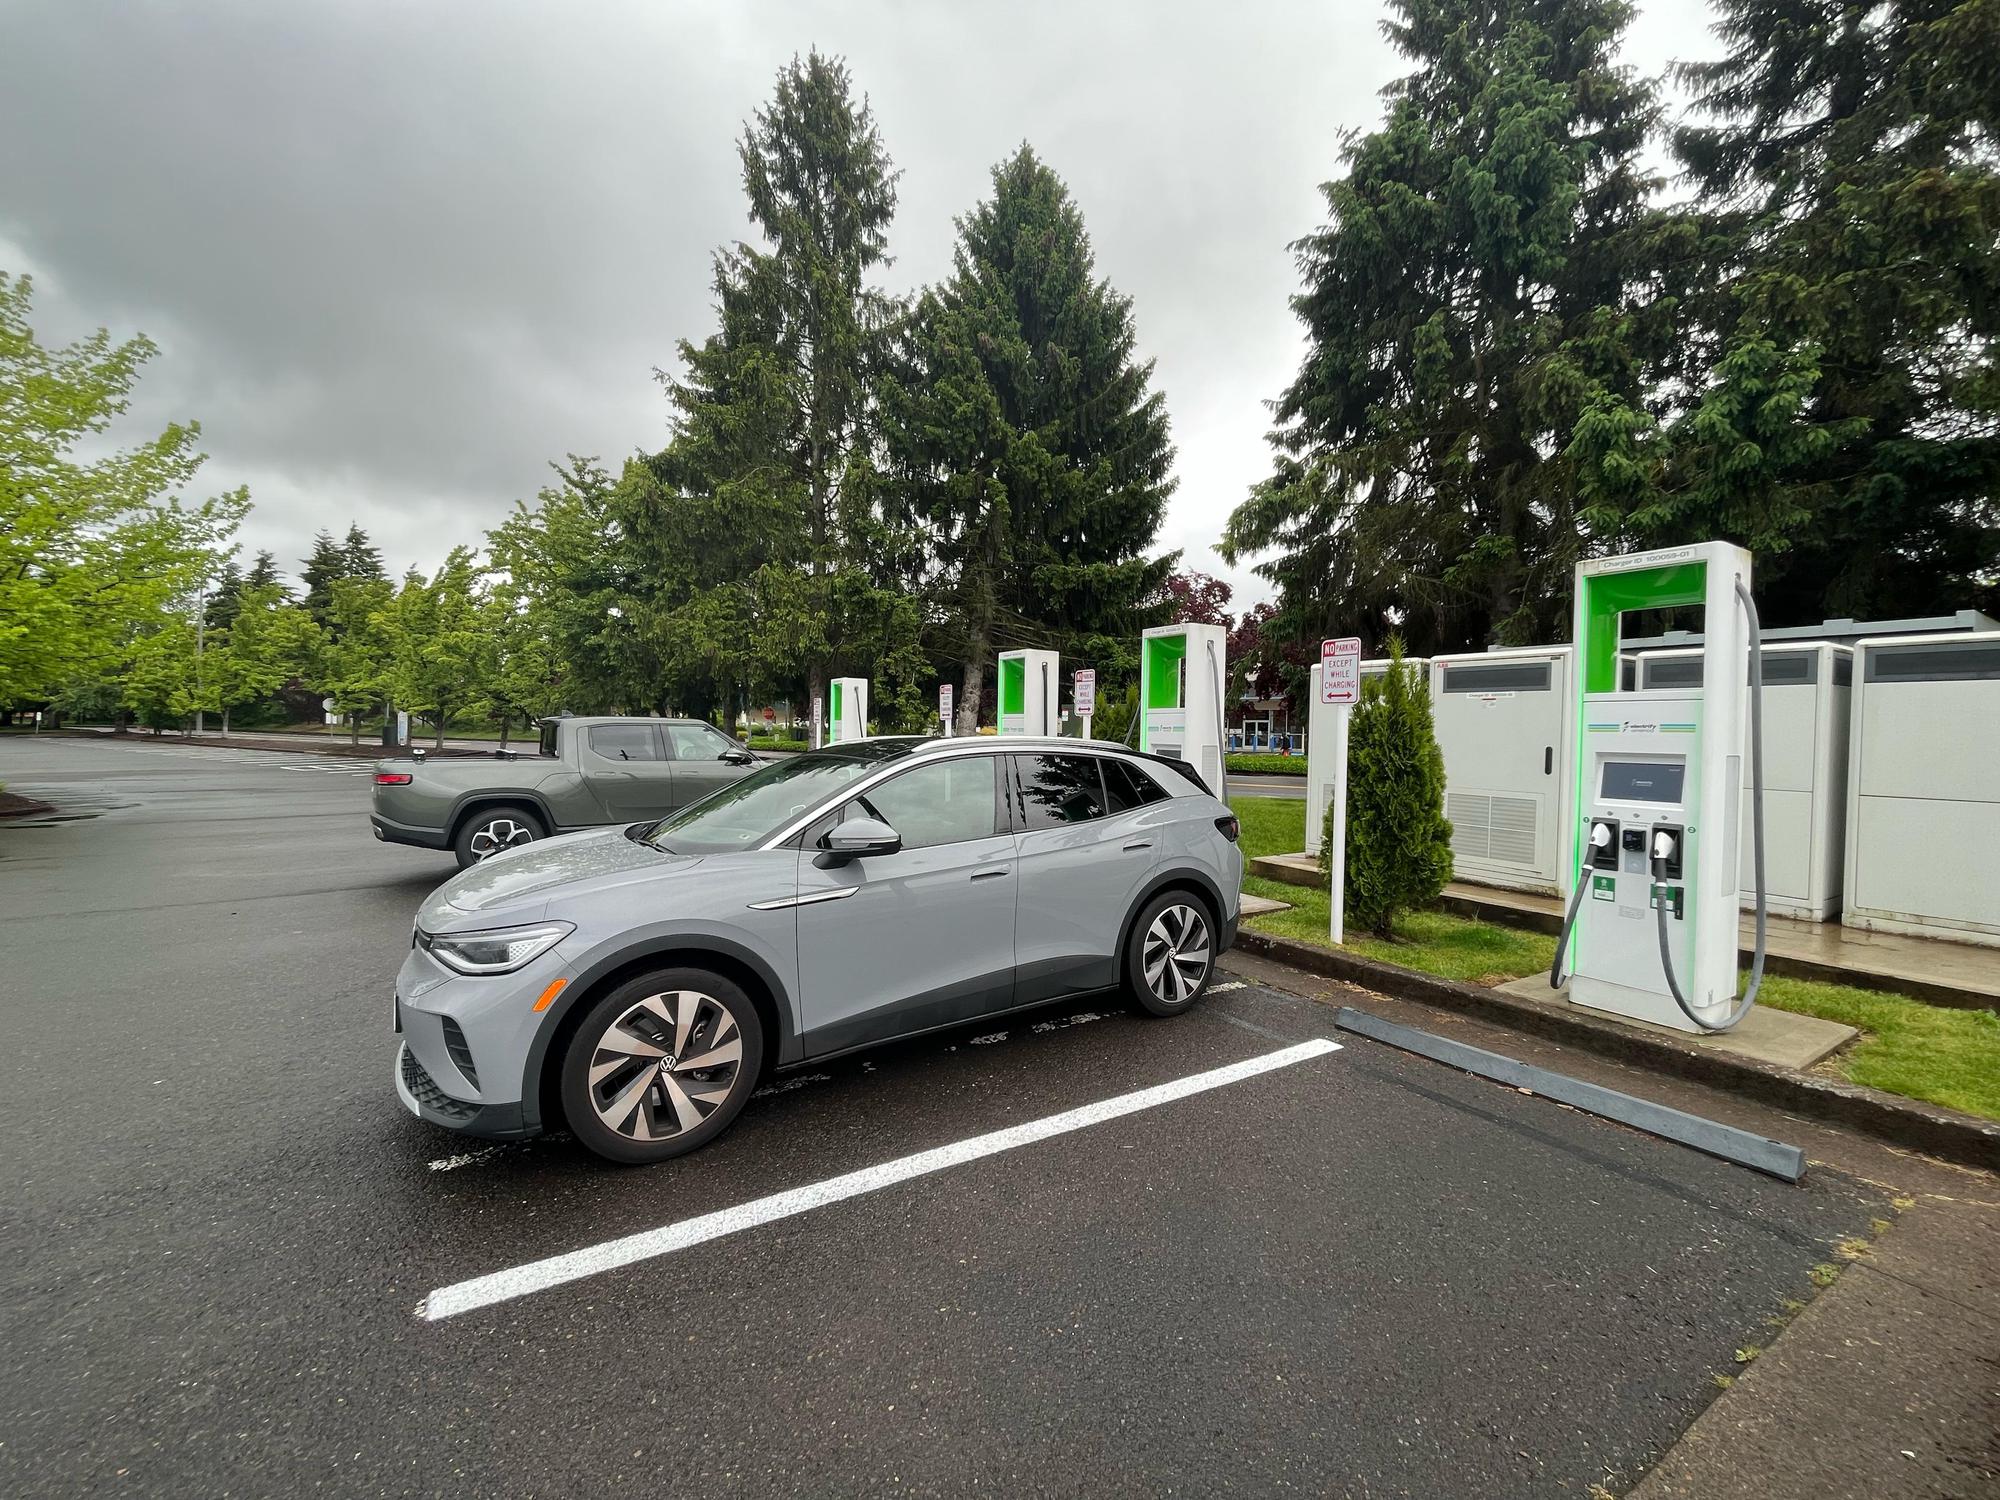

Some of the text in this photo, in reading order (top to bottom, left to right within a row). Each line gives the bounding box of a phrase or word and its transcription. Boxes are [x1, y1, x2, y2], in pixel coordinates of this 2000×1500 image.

[1603, 560, 1632, 568] Charger
[1324, 643, 1358, 655] NO PARKING
[1328, 659, 1353, 668] EXCEPT
[1330, 670, 1350, 678] WHILE
[1324, 680, 1356, 689] CHARGING
